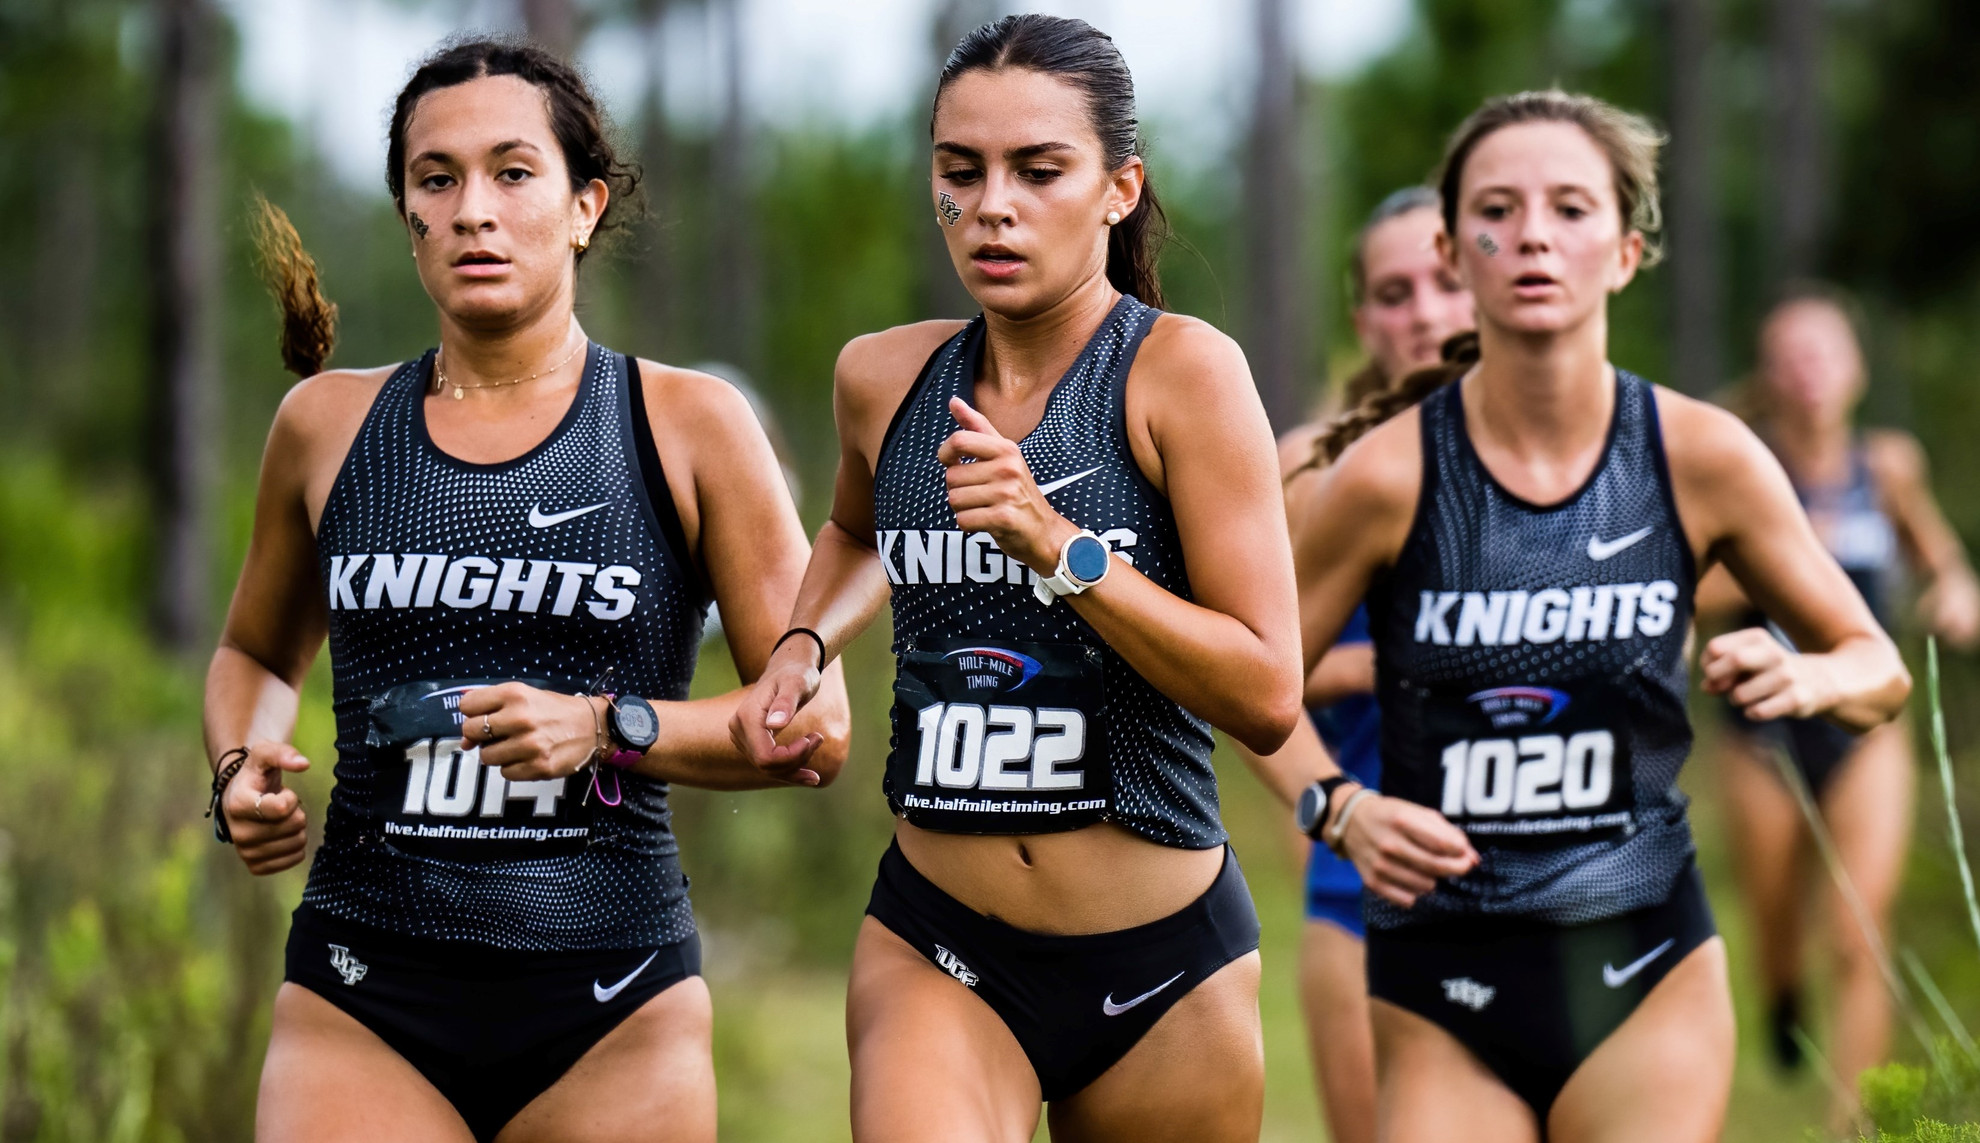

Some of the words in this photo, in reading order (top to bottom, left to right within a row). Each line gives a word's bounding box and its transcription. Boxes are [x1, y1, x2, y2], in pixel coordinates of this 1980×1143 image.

[938, 190, 963, 226] UCF
[329, 553, 641, 620] KNIGHTS
[1414, 579, 1678, 647] KNIGHTS
[958, 656, 1015, 677] HALF-MILE
[966, 675, 999, 690] TIMING
[915, 702, 1086, 790] 1022
[1441, 730, 1615, 816] 1020
[904, 794, 1106, 814] live.halfmiletiming.com
[385, 822, 589, 841] live.halfmiletiming.com
[328, 943, 368, 985] UCF
[934, 943, 980, 987] UCF
